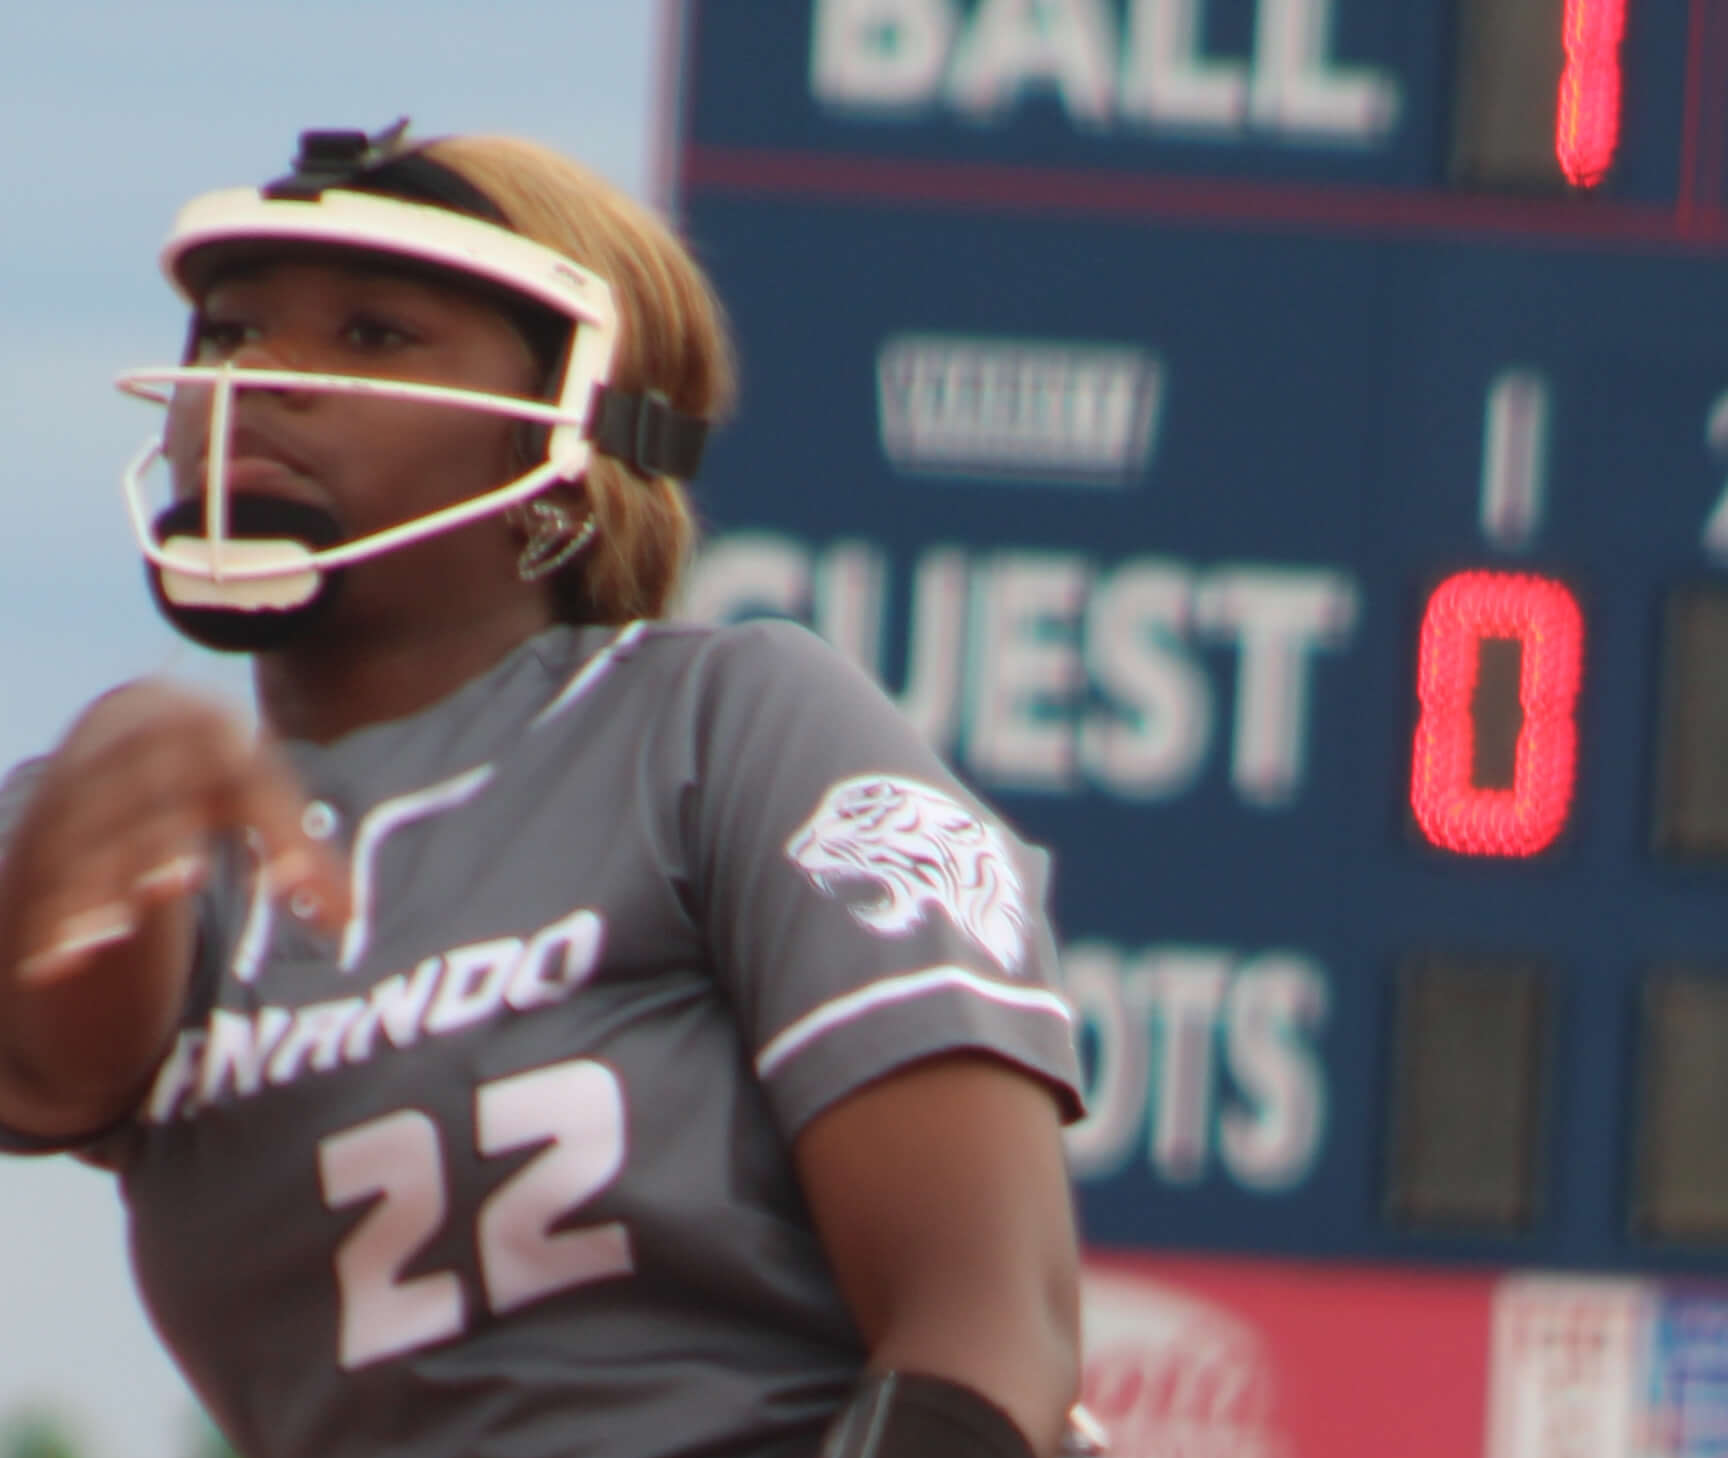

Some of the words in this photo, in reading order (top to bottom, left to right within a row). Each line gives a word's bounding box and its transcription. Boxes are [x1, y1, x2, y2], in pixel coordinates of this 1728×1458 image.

[812, 0, 1397, 138] BALL
[1410, 569, 1583, 857] 0
[318, 1058, 634, 1372] 22
